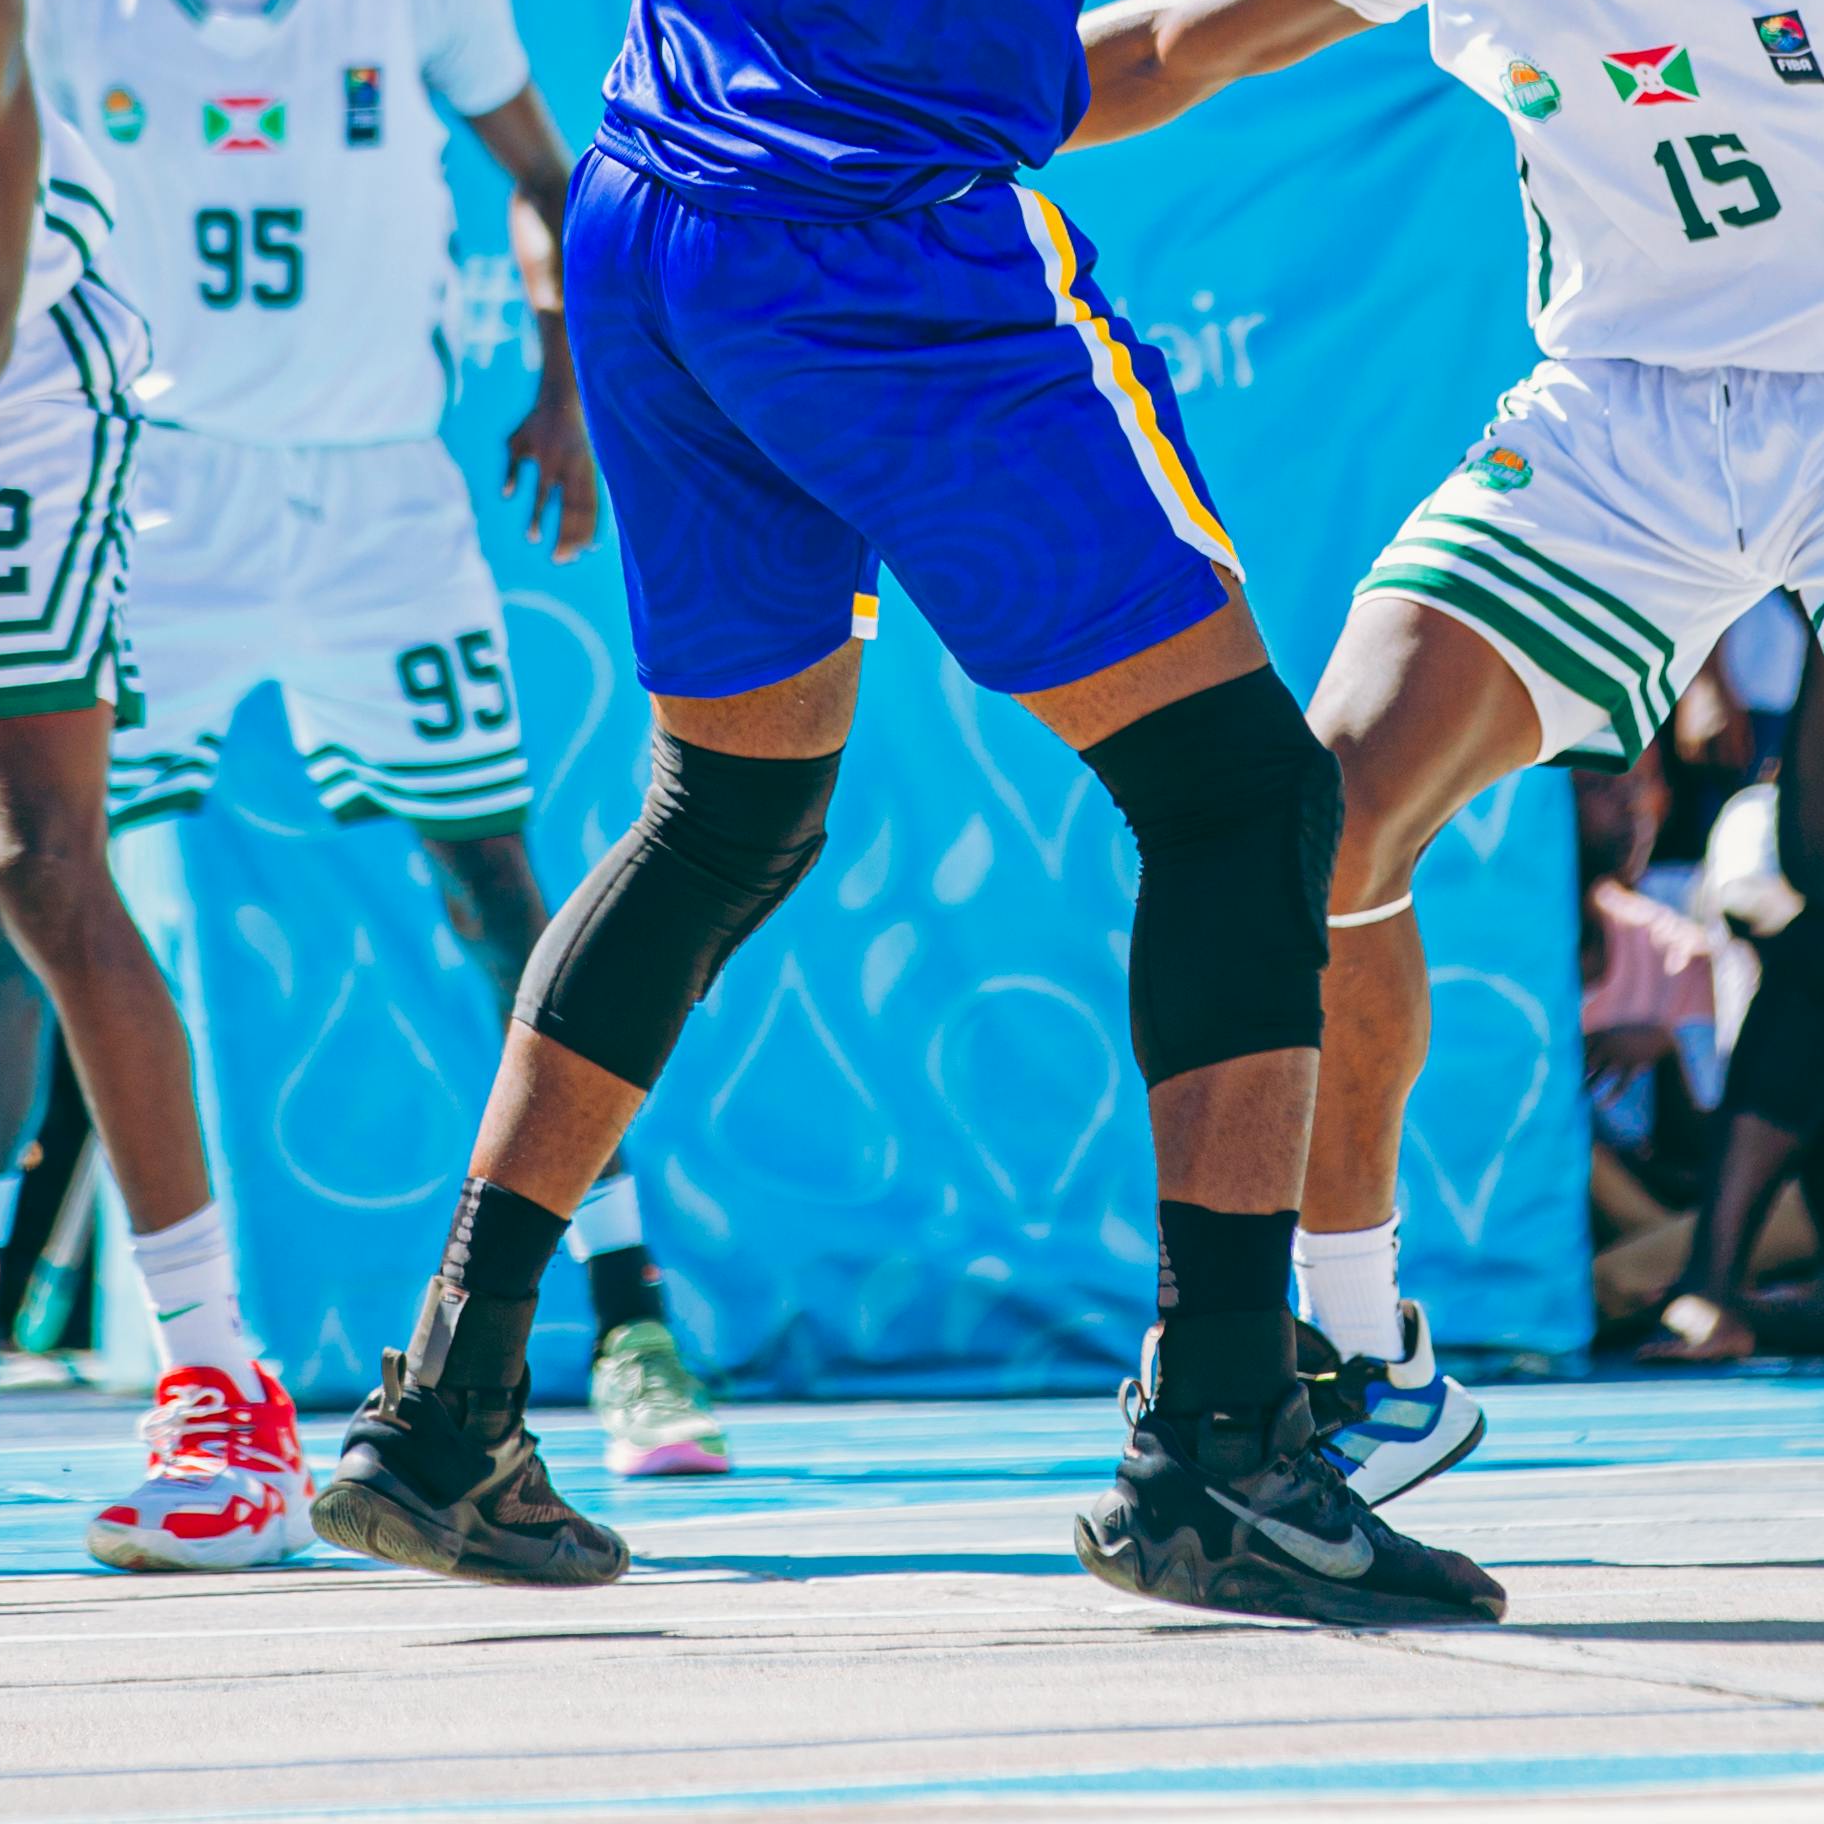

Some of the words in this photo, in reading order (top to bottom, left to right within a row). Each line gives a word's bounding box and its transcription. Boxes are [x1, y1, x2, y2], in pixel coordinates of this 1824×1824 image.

[1776, 57, 1814, 73] FIBA
[1653, 132, 1782, 243] 15
[195, 207, 305, 311] 95
[395, 627, 513, 744] 95
